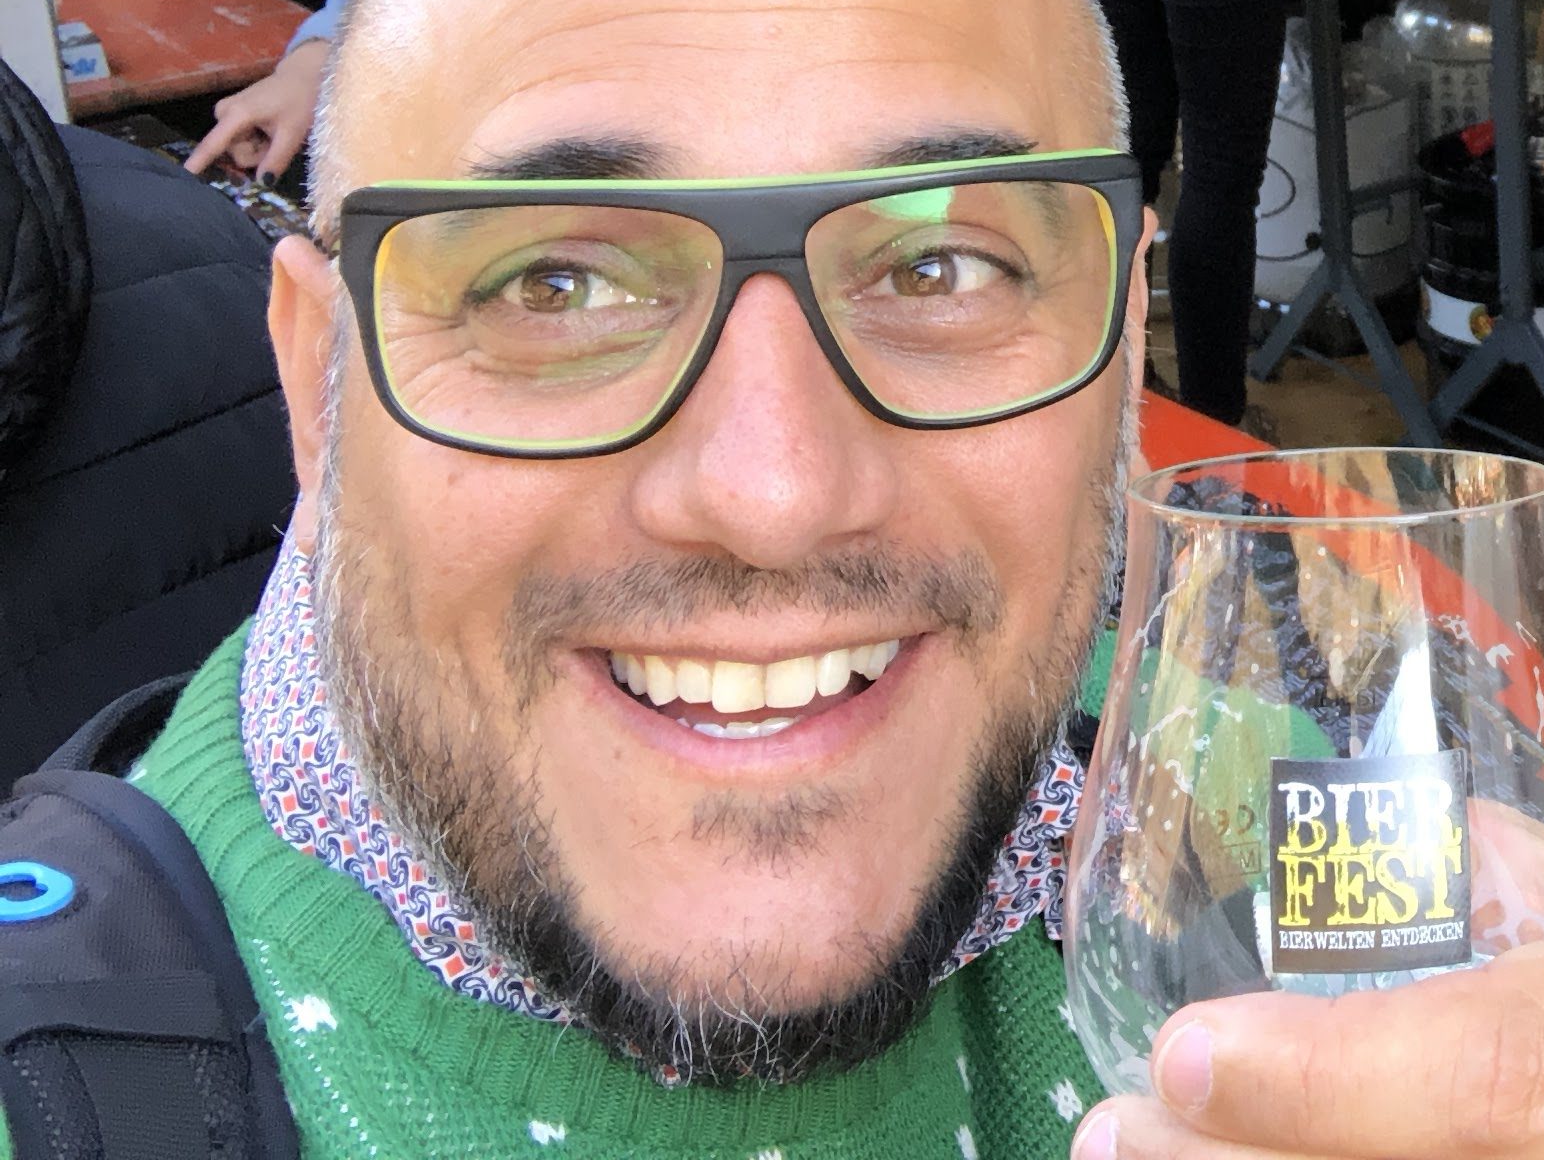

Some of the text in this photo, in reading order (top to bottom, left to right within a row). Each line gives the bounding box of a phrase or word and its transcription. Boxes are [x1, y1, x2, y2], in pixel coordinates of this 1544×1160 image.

[1277, 777, 1463, 854] BIER
[1276, 845, 1463, 926] FEST
[1278, 920, 1465, 950] BIERWELTEN ENTDECKEN
